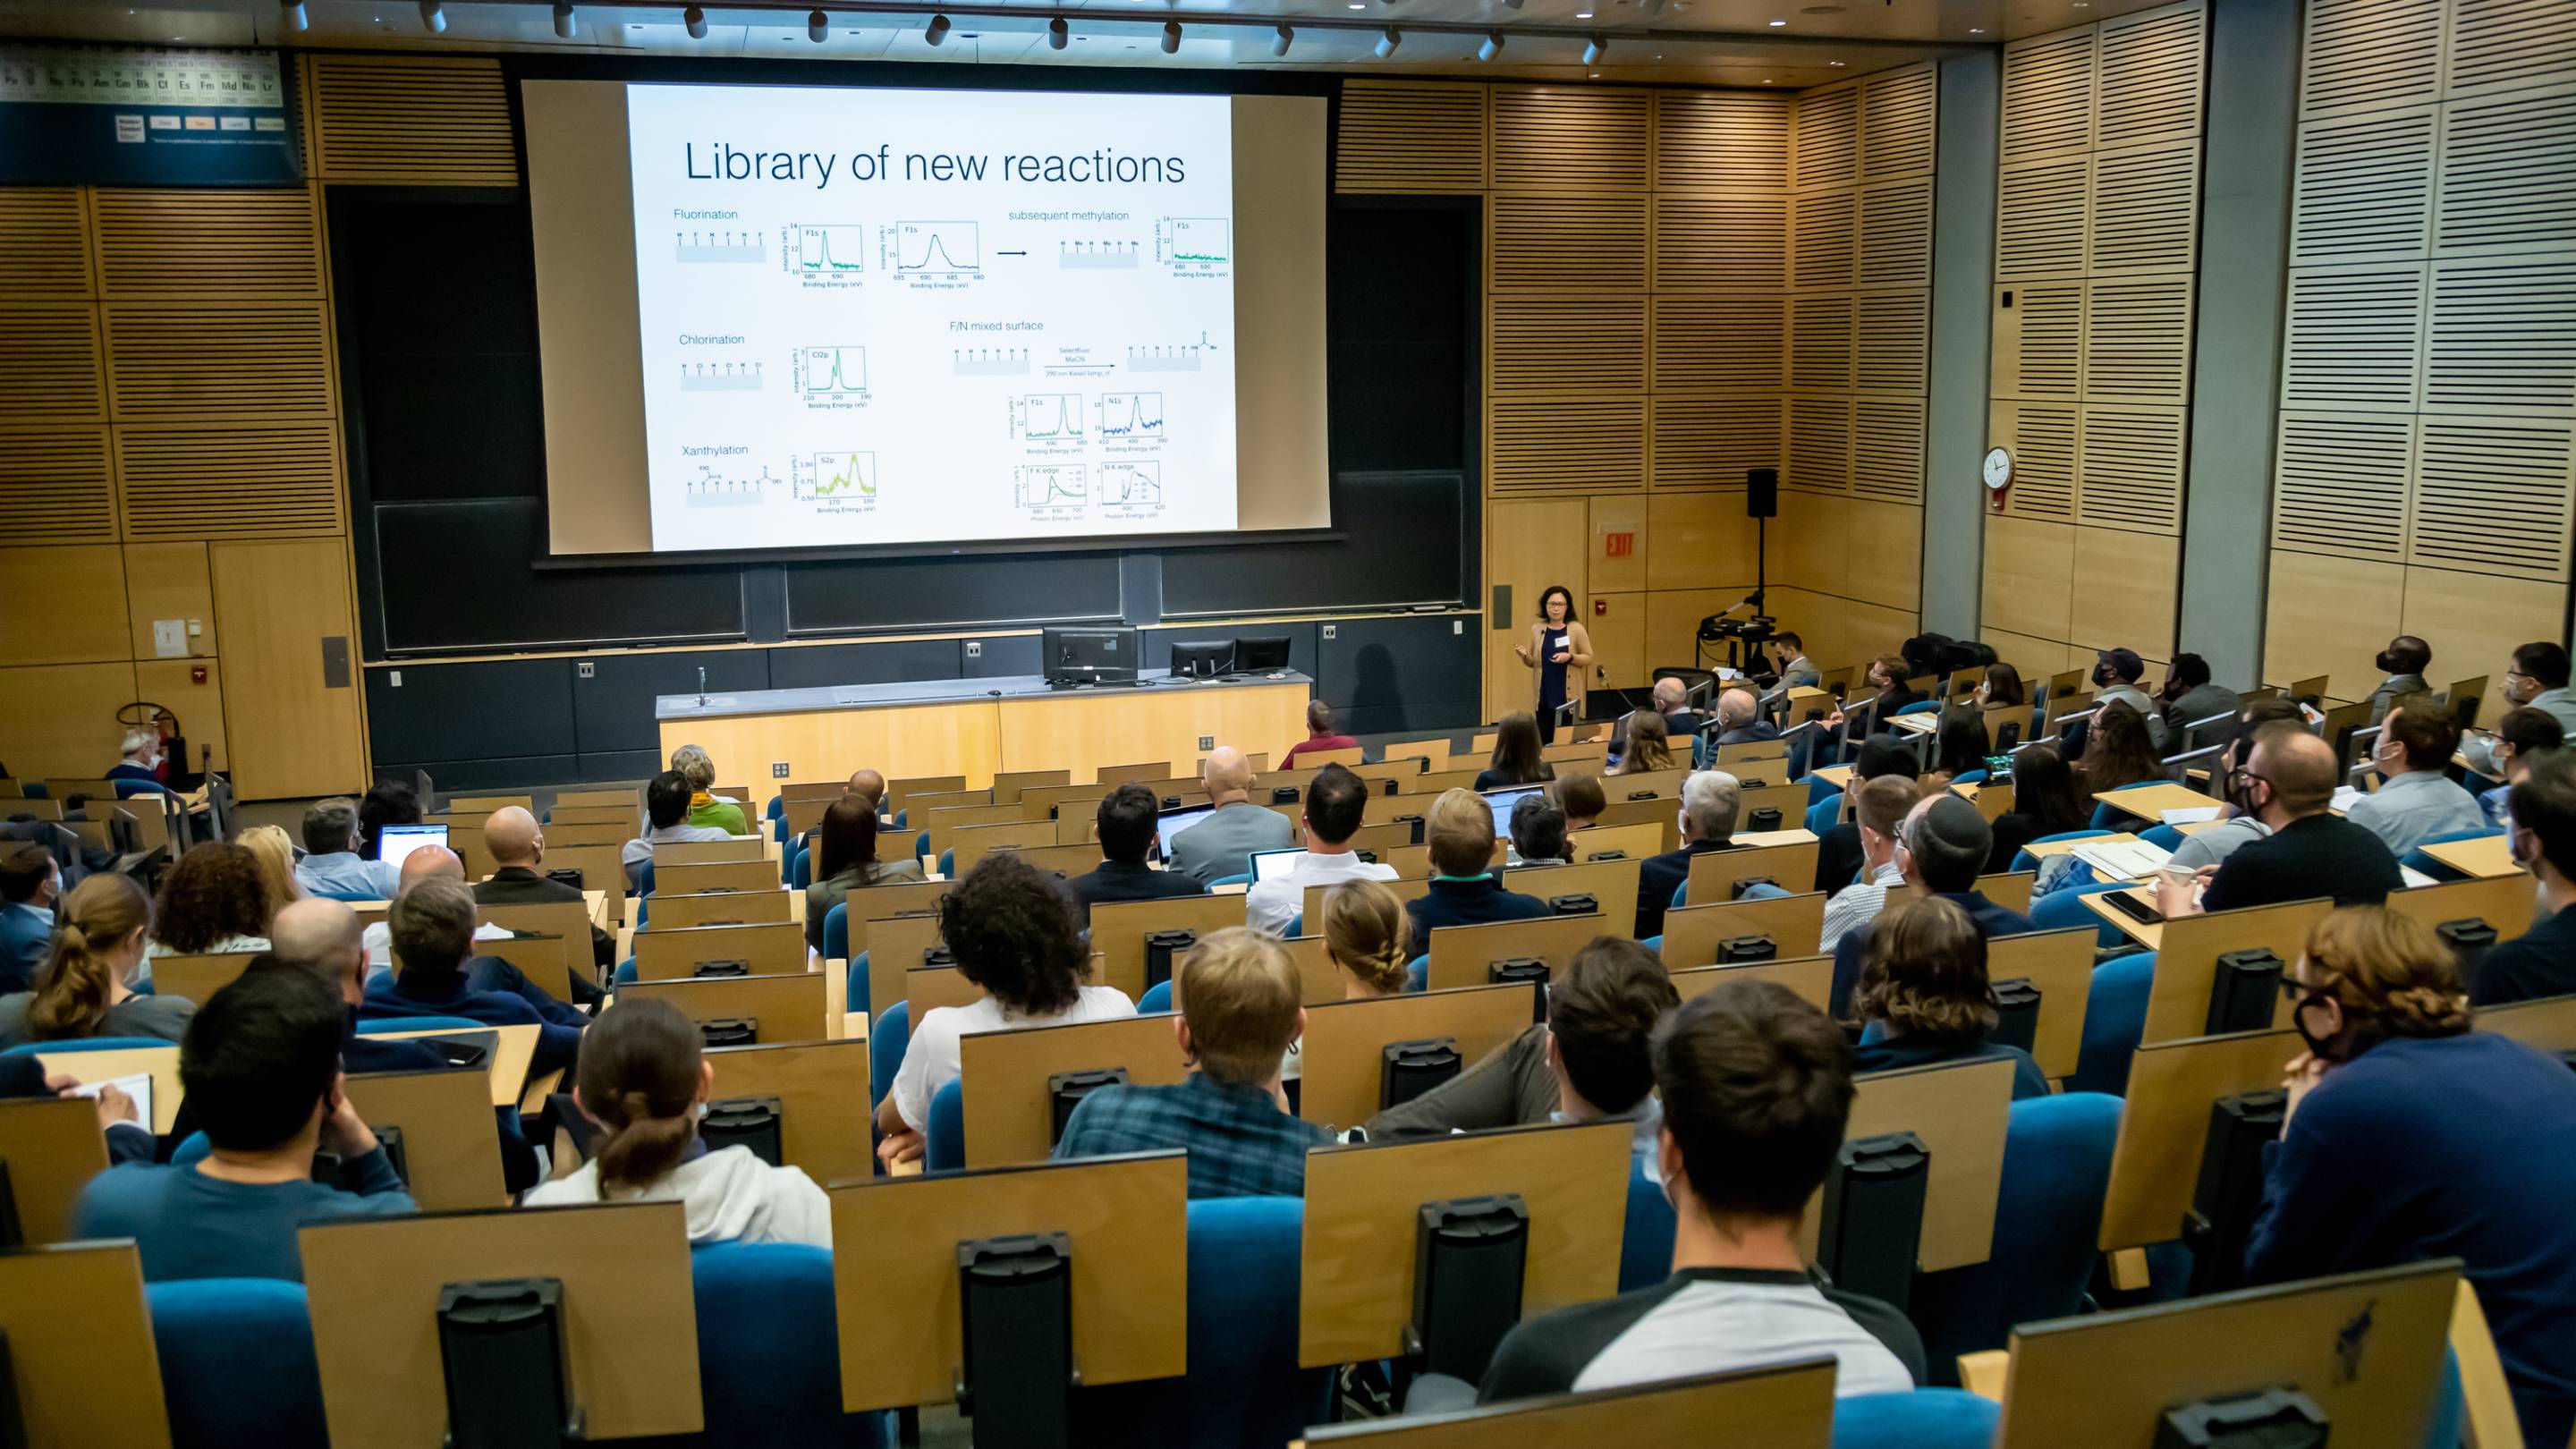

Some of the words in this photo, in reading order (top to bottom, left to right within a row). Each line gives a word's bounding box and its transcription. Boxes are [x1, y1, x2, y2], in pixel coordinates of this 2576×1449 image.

[137, 80, 149, 88] Bk
[180, 80, 190, 89] Es
[200, 81, 214, 89] Fm
[222, 81, 236, 90] Md
[242, 81, 255, 90] No
[263, 81, 272, 90] Lr
[686, 142, 835, 189] Library
[852, 144, 889, 181] of
[905, 152, 988, 181] new
[1004, 148, 1185, 182] reactions
[674, 209, 739, 219] Fluorination
[1009, 211, 1069, 223] subsequent
[1072, 211, 1129, 222] methylation
[950, 321, 968, 331] F/N
[970, 321, 1003, 331] mixed
[1005, 321, 1044, 331] surface
[679, 335, 745, 345] Chlorination
[812, 351, 829, 359] Cl2p
[682, 445, 749, 457] Xanthylation
[1606, 532, 1632, 556] EXIT
